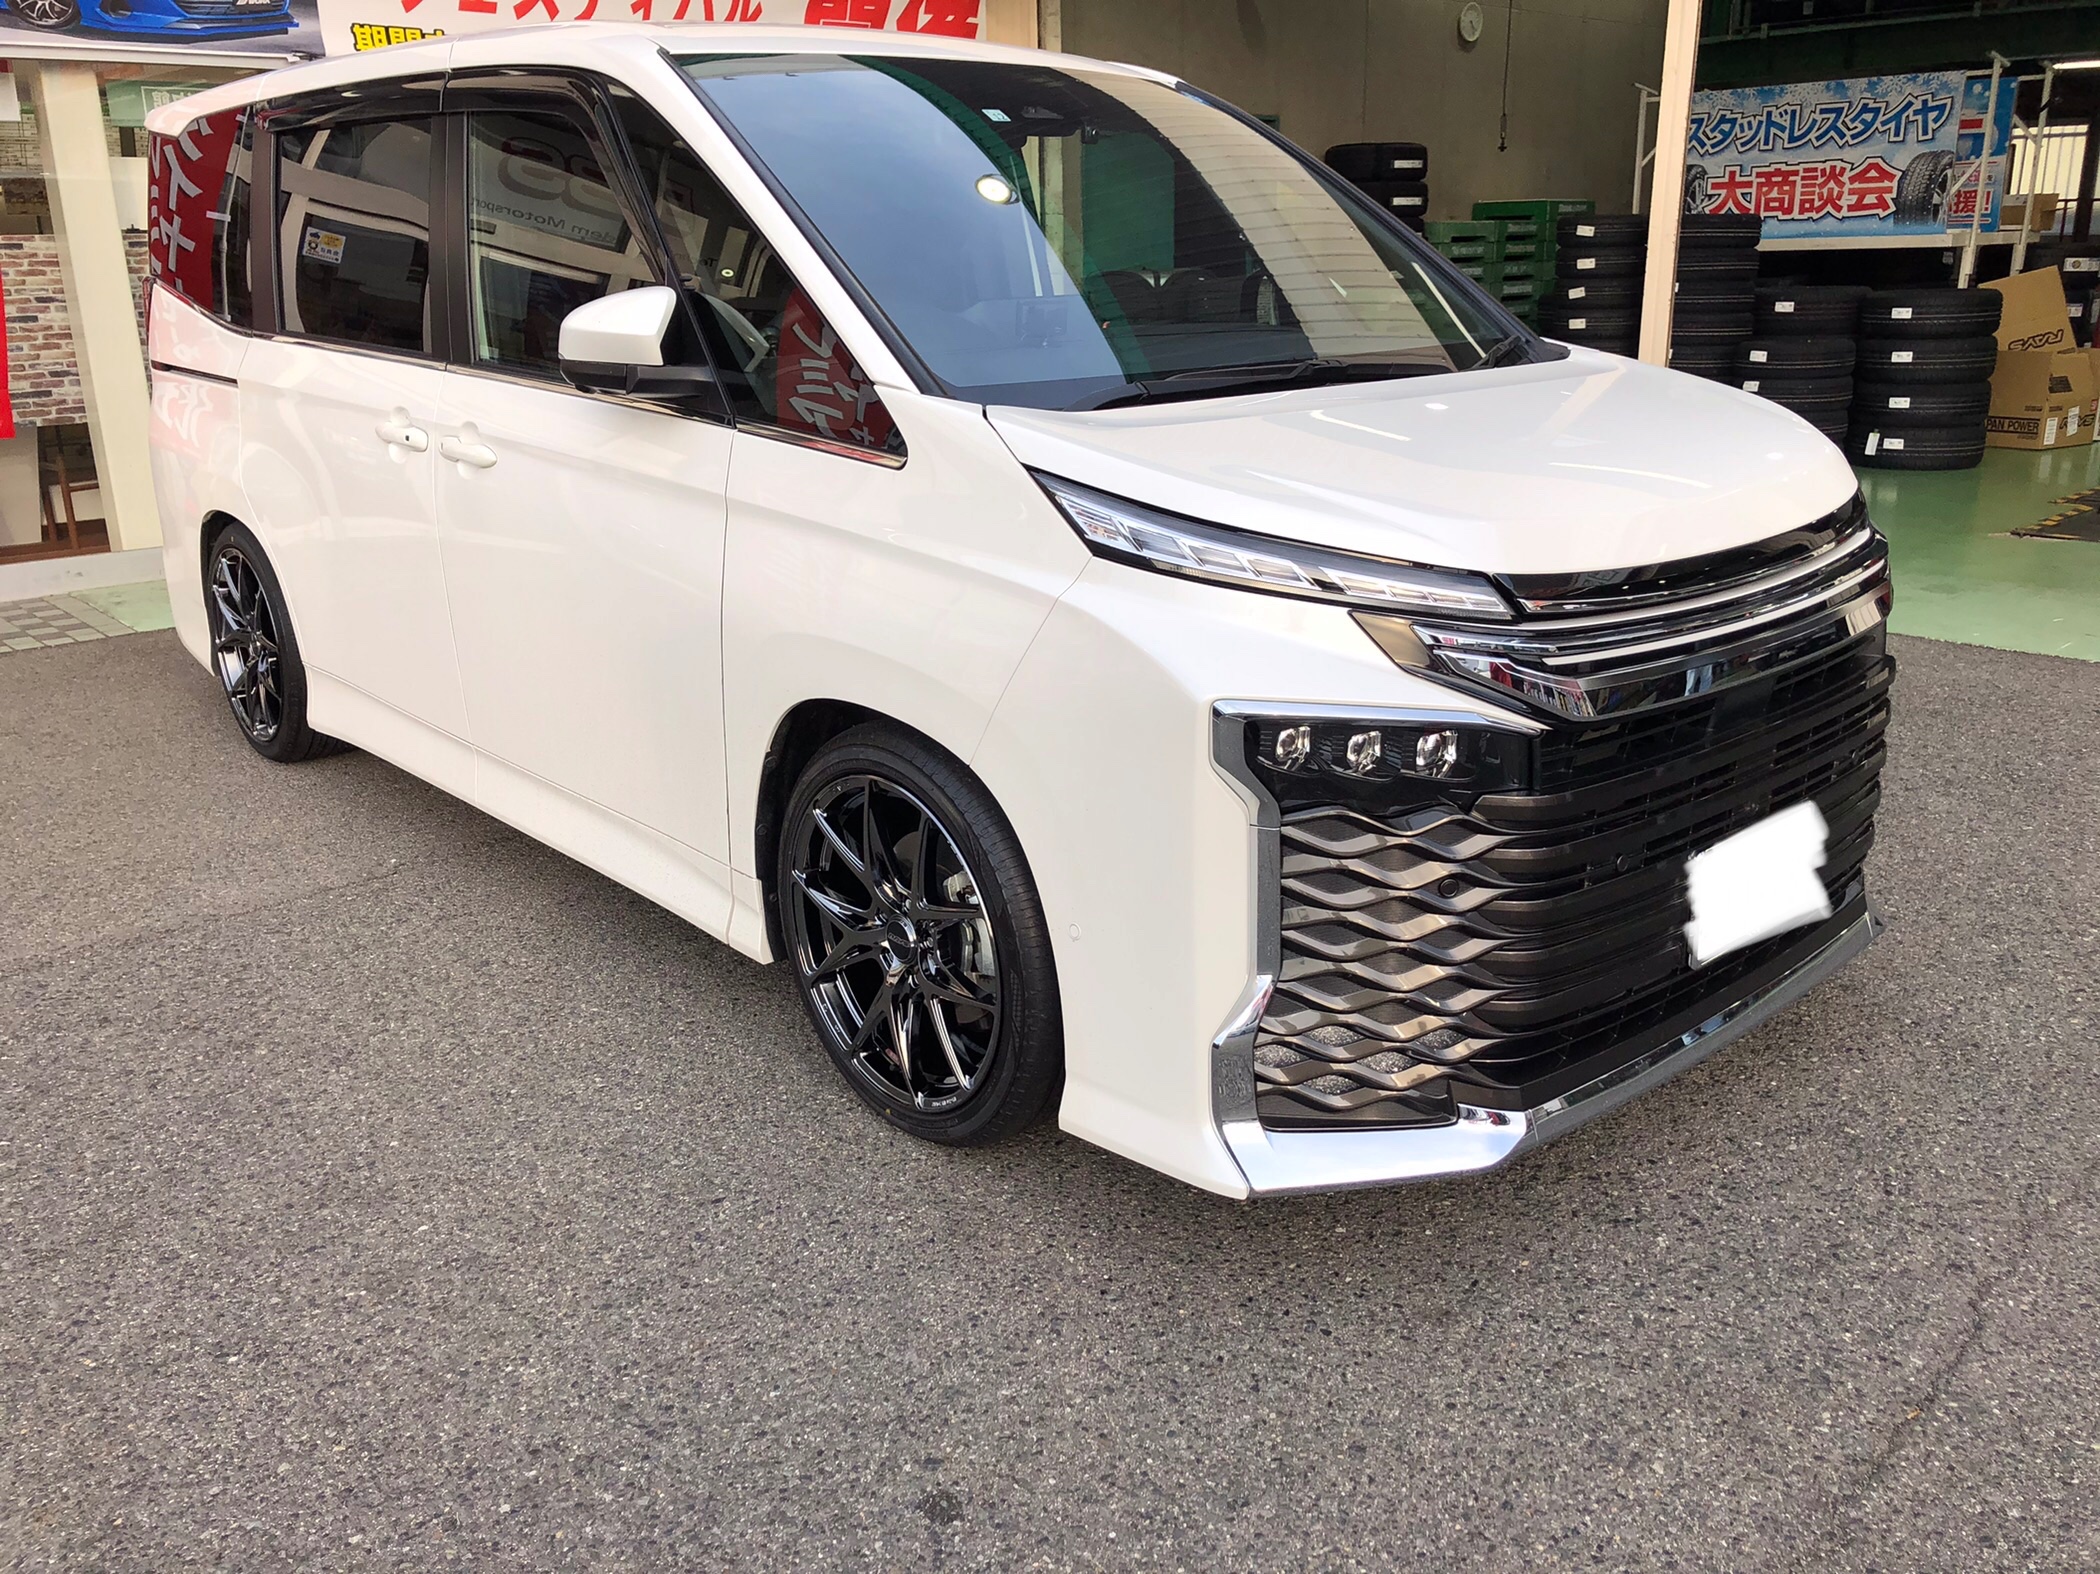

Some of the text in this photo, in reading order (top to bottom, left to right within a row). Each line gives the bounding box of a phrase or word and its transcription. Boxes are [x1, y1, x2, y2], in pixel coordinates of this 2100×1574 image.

[1688, 96, 1951, 154] スタッドレスタイヤ
[1708, 159, 1899, 218] 大商談会
[1948, 189, 1991, 214] 援!
[2008, 329, 2064, 351] RAYS
[2007, 420, 2040, 432] POWER
